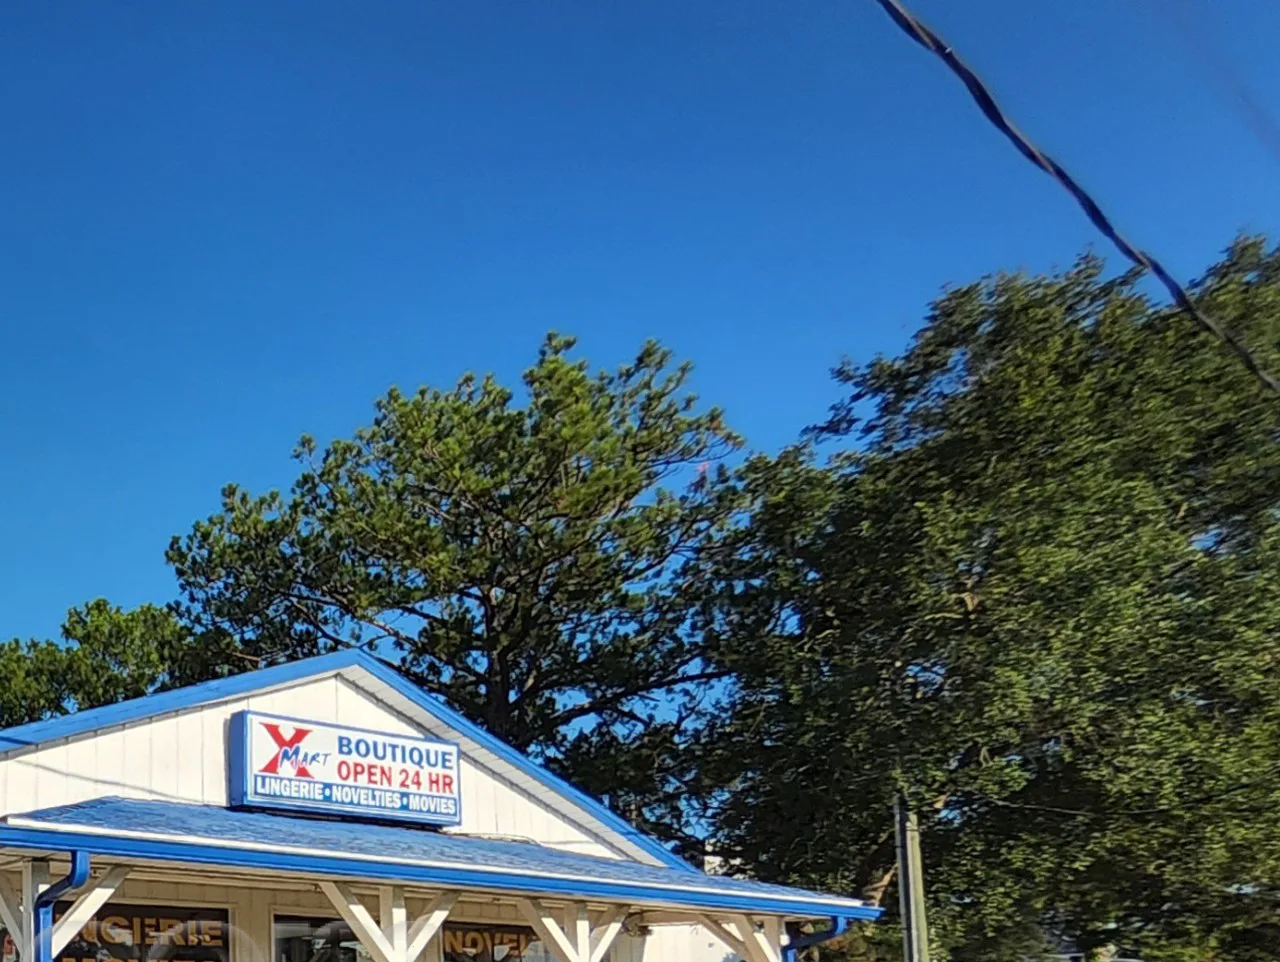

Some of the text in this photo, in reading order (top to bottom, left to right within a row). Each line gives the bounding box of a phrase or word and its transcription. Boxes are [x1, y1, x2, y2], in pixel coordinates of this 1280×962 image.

[258, 722, 315, 779] X
[337, 736, 454, 770] BOUTIQUE
[256, 776, 456, 815] LINGERIE NOVELTIES MOVIES
[337, 761, 454, 794] OPEN 24 HR
